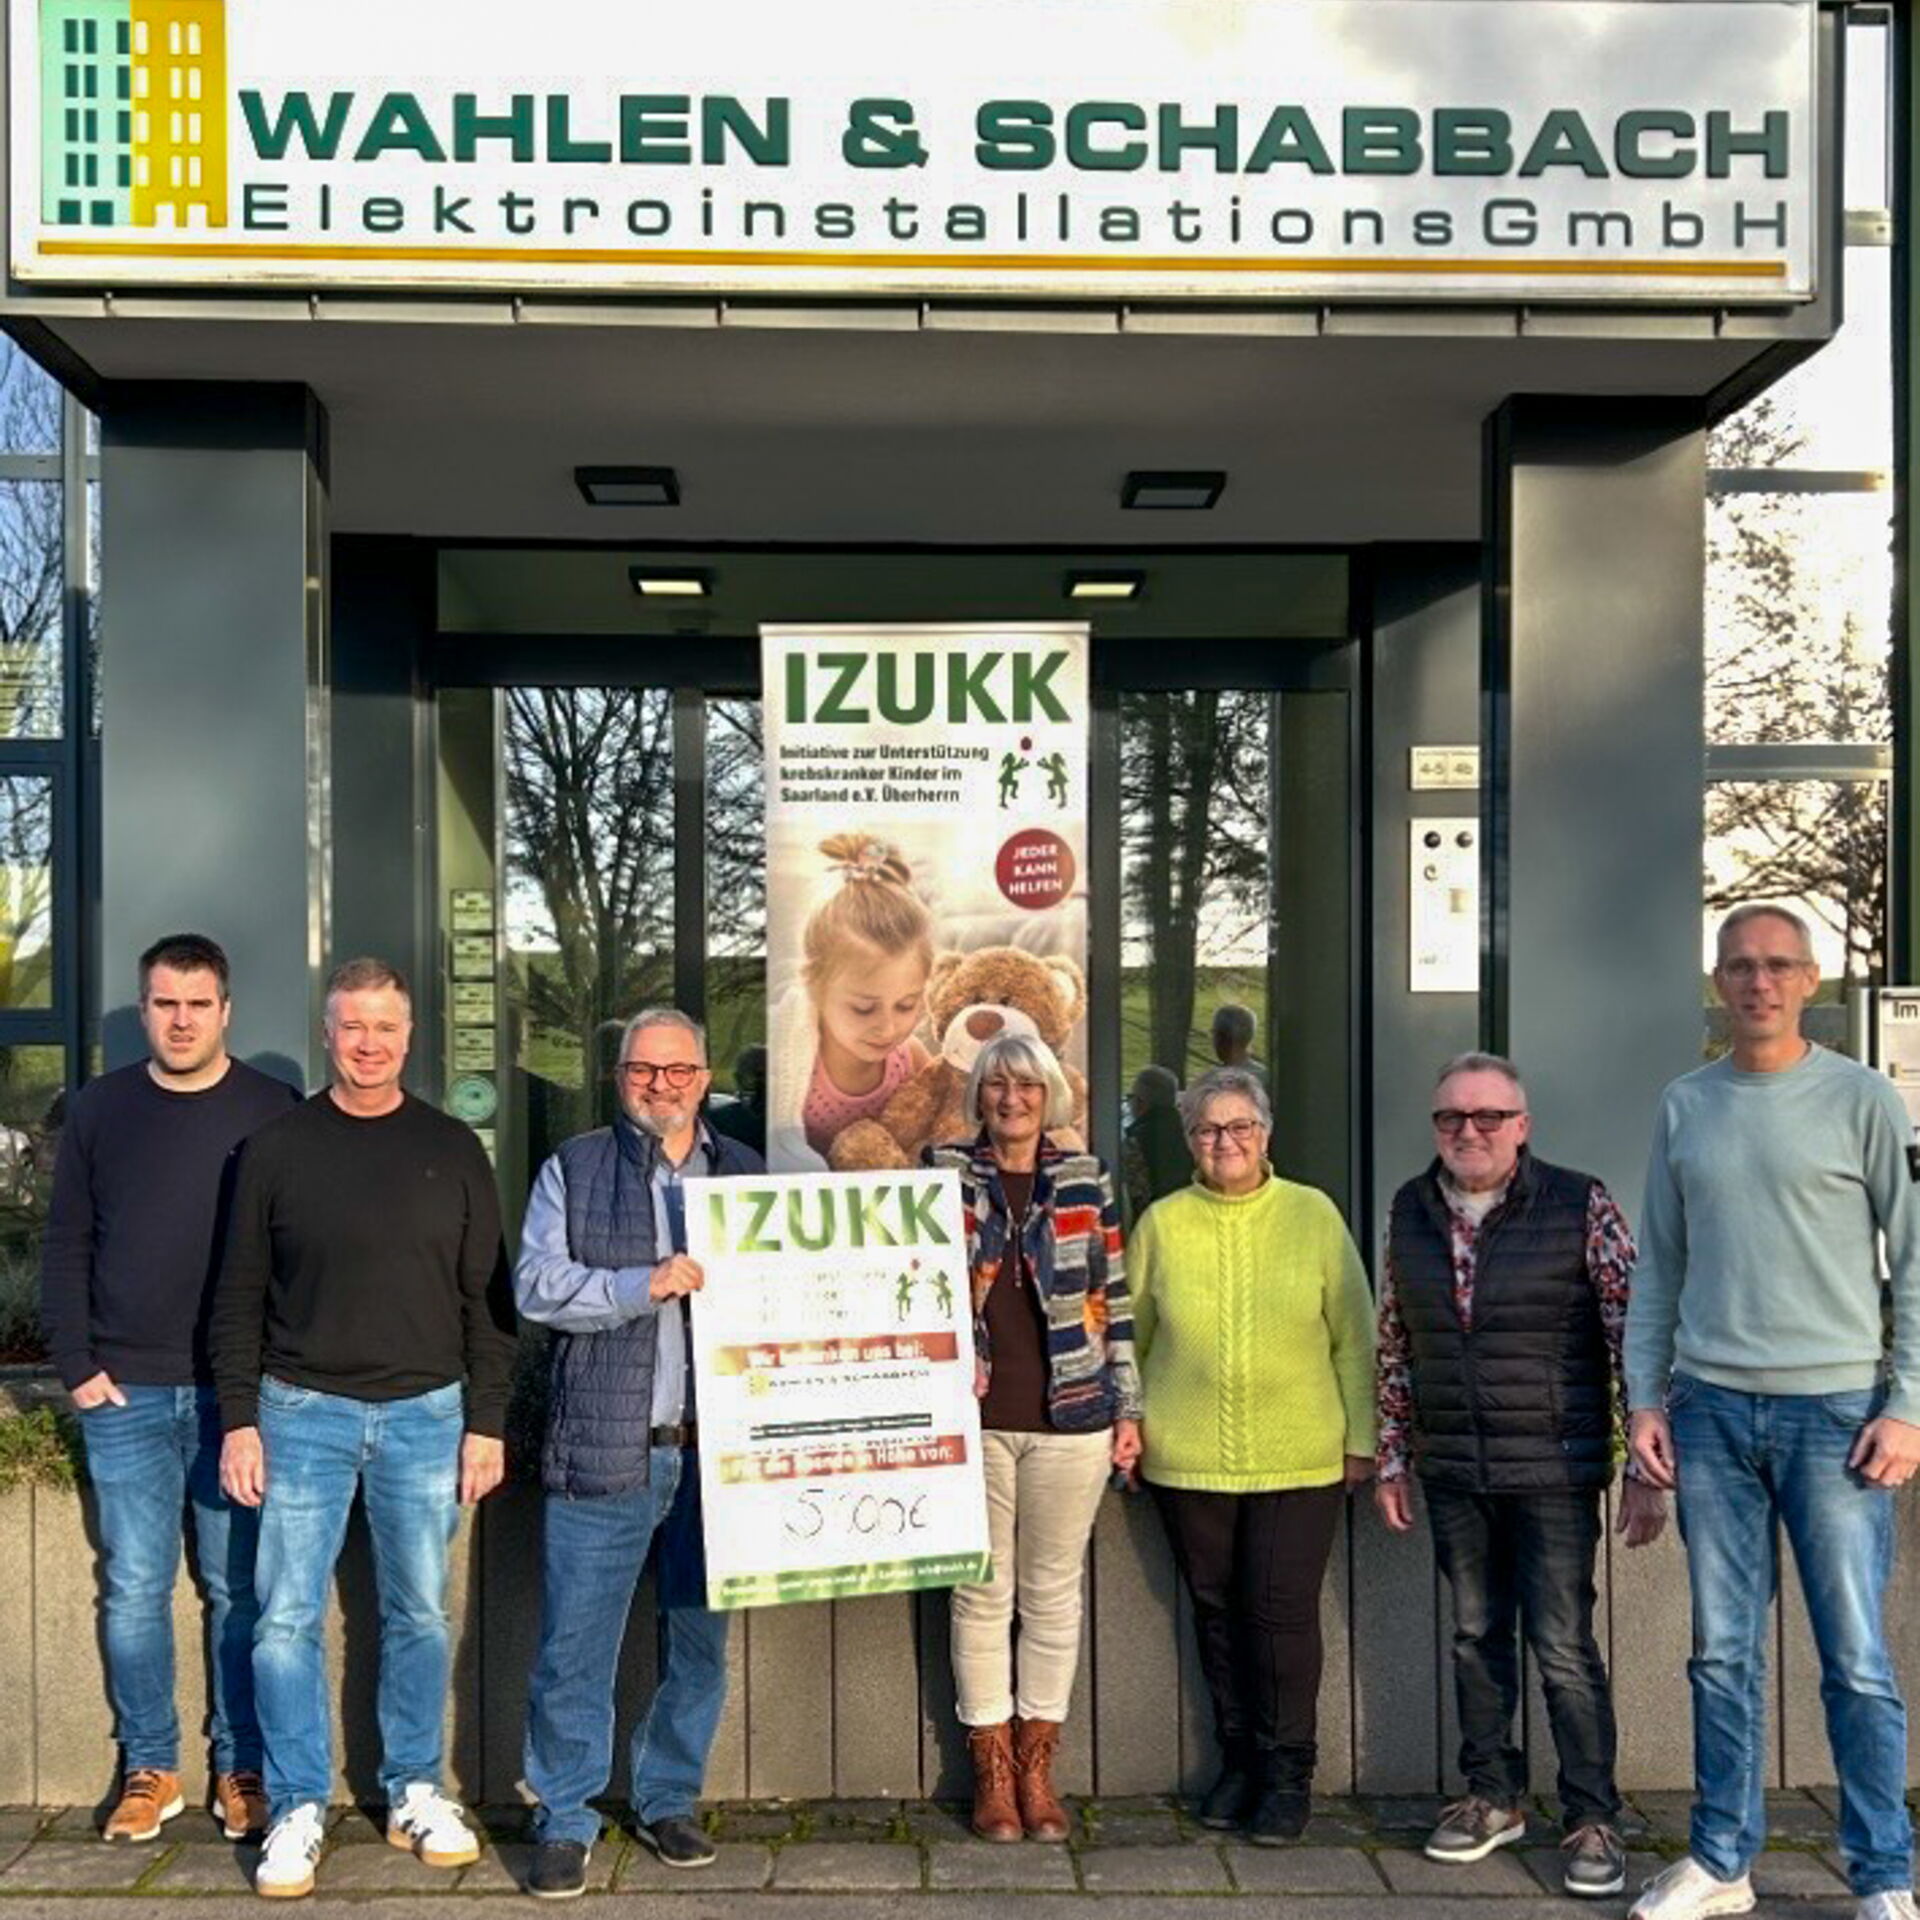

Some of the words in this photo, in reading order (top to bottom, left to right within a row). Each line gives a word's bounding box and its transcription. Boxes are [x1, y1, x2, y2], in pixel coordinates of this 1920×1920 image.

[239, 91, 790, 167] WAHLEN
[842, 97, 930, 169] &
[975, 100, 1790, 180] SCHABBACH
[786, 652, 1072, 724] IZUKK
[779, 745, 849, 760] Initiative
[852, 748, 876, 760] zur
[879, 744, 990, 762] Unterstützung
[780, 766, 886, 781] krebskranker
[888, 766, 938, 781] Kinder
[942, 766, 963, 781] im
[781, 787, 848, 803] Saarland
[852, 788, 878, 803] e.V.
[882, 784, 960, 803] Überherrn
[1012, 844, 1057, 860] JEDER
[1014, 861, 1057, 877] KANN
[1009, 878, 1063, 895] HELFEN
[708, 1183, 951, 1253] IZUKK
